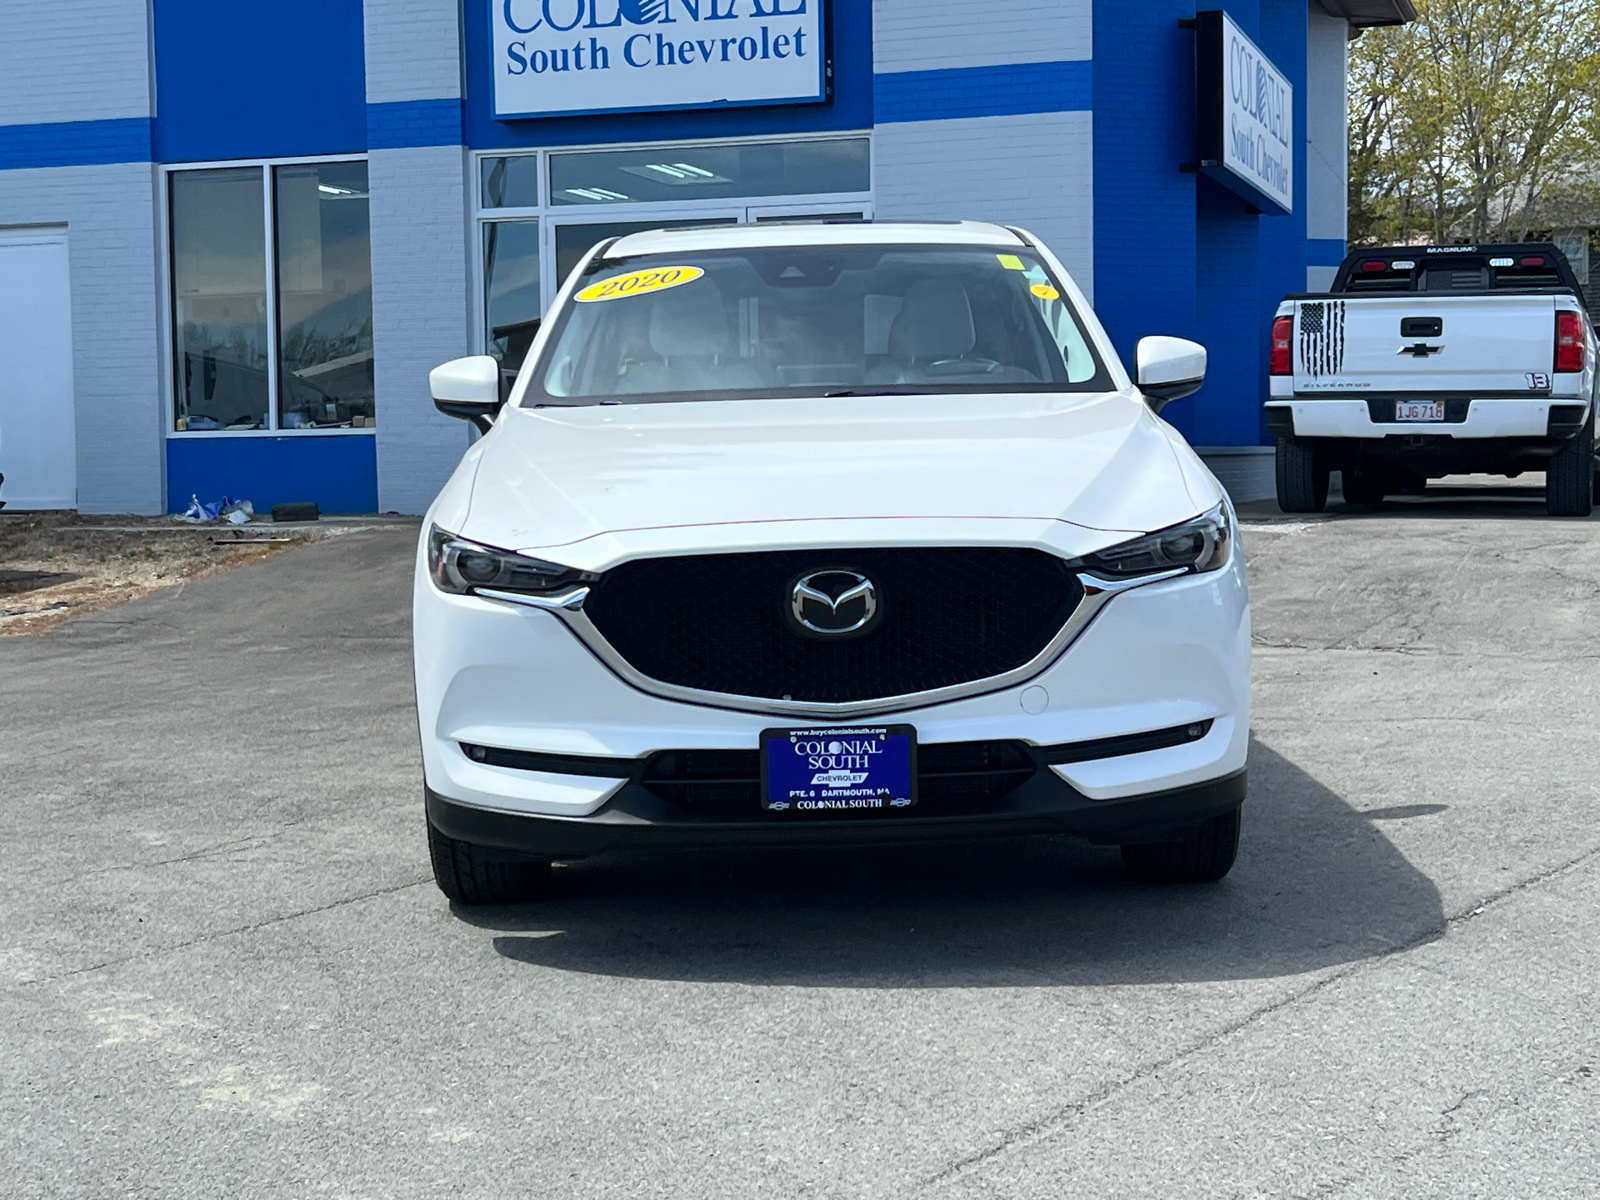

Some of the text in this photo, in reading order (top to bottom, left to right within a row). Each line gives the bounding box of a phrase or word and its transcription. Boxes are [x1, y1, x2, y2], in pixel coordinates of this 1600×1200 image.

[506, 26, 807, 75] South Chevrolet
[1230, 35, 1289, 149] COLONIAL
[1231, 112, 1289, 196] South Chevrolet
[597, 269, 682, 298] 2020
[1525, 372, 1550, 389] 13
[1421, 405, 1443, 418] 718
[790, 728, 887, 737] www.buycolonialsouth.com
[794, 740, 883, 755] COLONIAL
[808, 755, 869, 769] SOUTH
[816, 774, 863, 782] CHEVROLET
[821, 789, 876, 797] DARTMOUTH,
[797, 799, 882, 810] COLONIAL SOUTH
